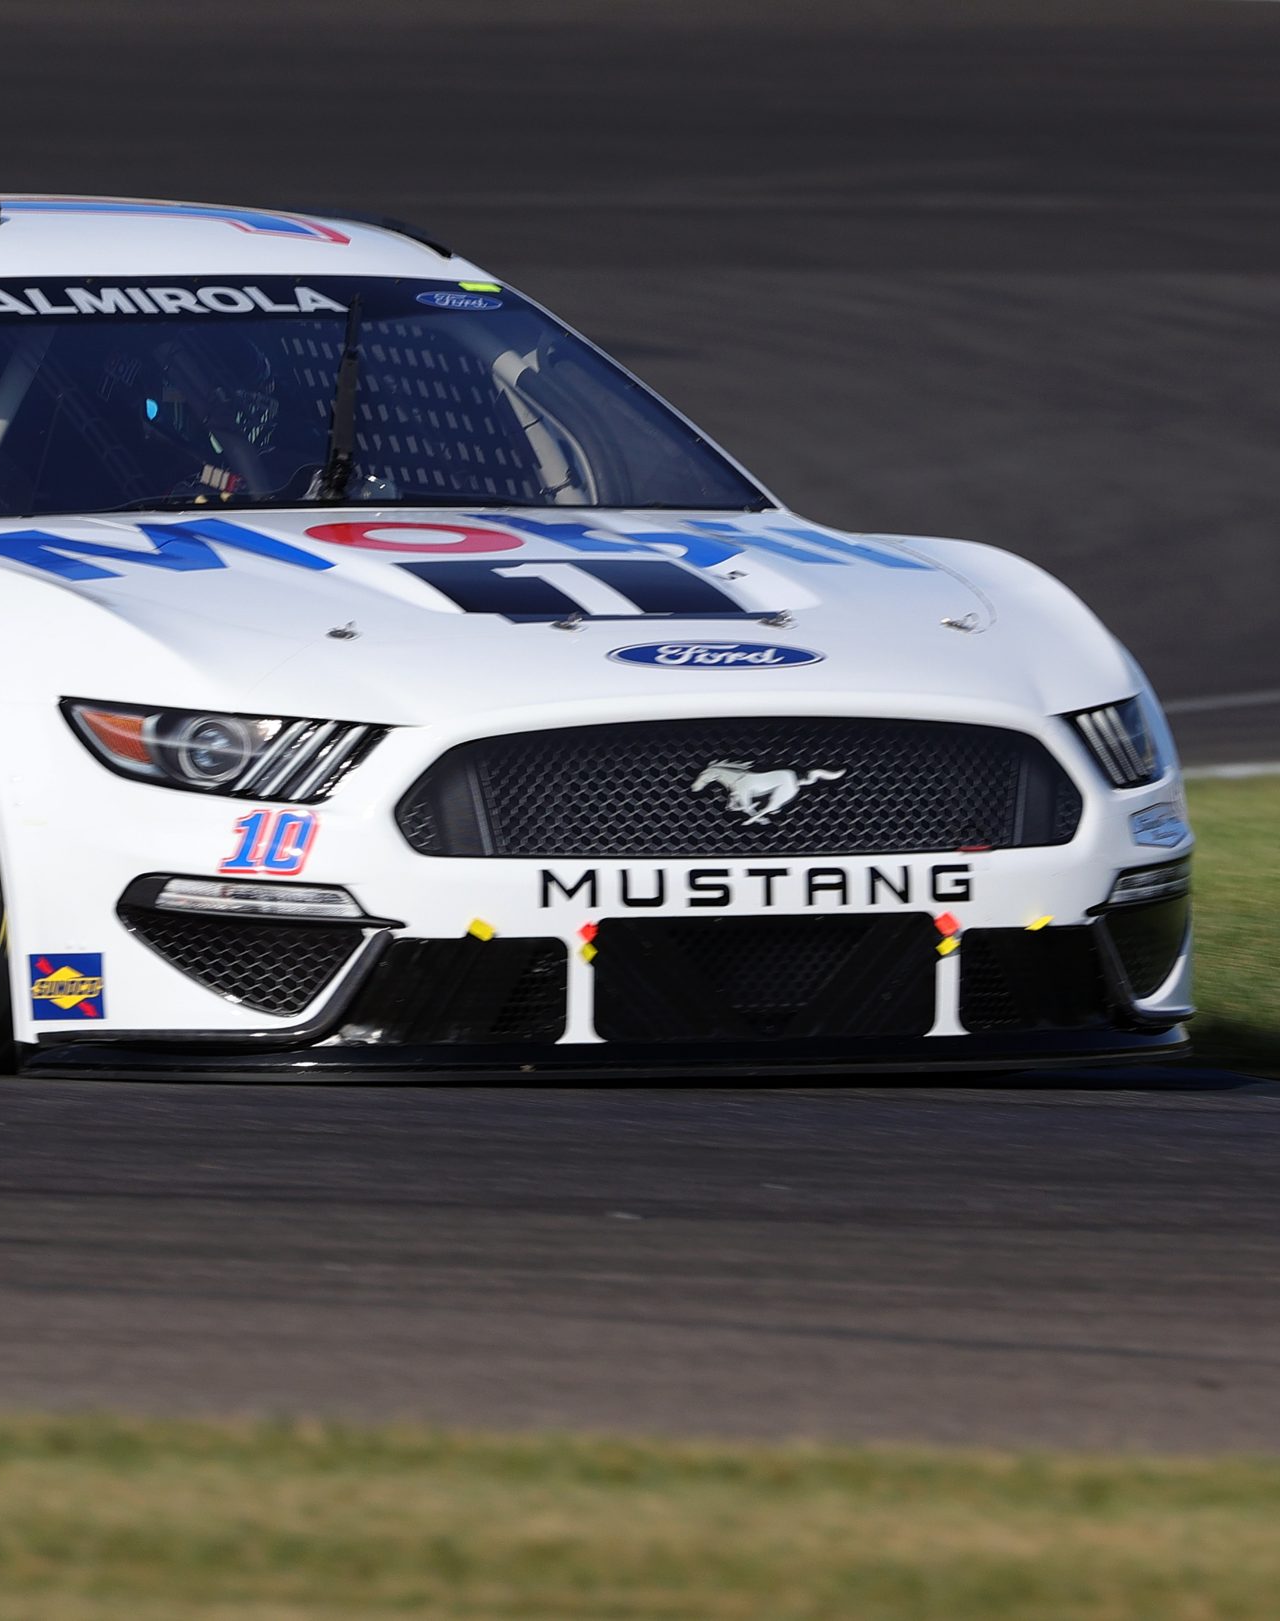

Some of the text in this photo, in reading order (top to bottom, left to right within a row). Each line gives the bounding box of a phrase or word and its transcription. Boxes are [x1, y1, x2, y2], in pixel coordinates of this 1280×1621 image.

[433, 294, 489, 308] Ford
[490, 563, 646, 615] 1
[655, 645, 785, 665] Ford
[217, 808, 320, 876] 10
[539, 863, 974, 909] MUSTANG
[31, 979, 103, 997] SUNOCO
